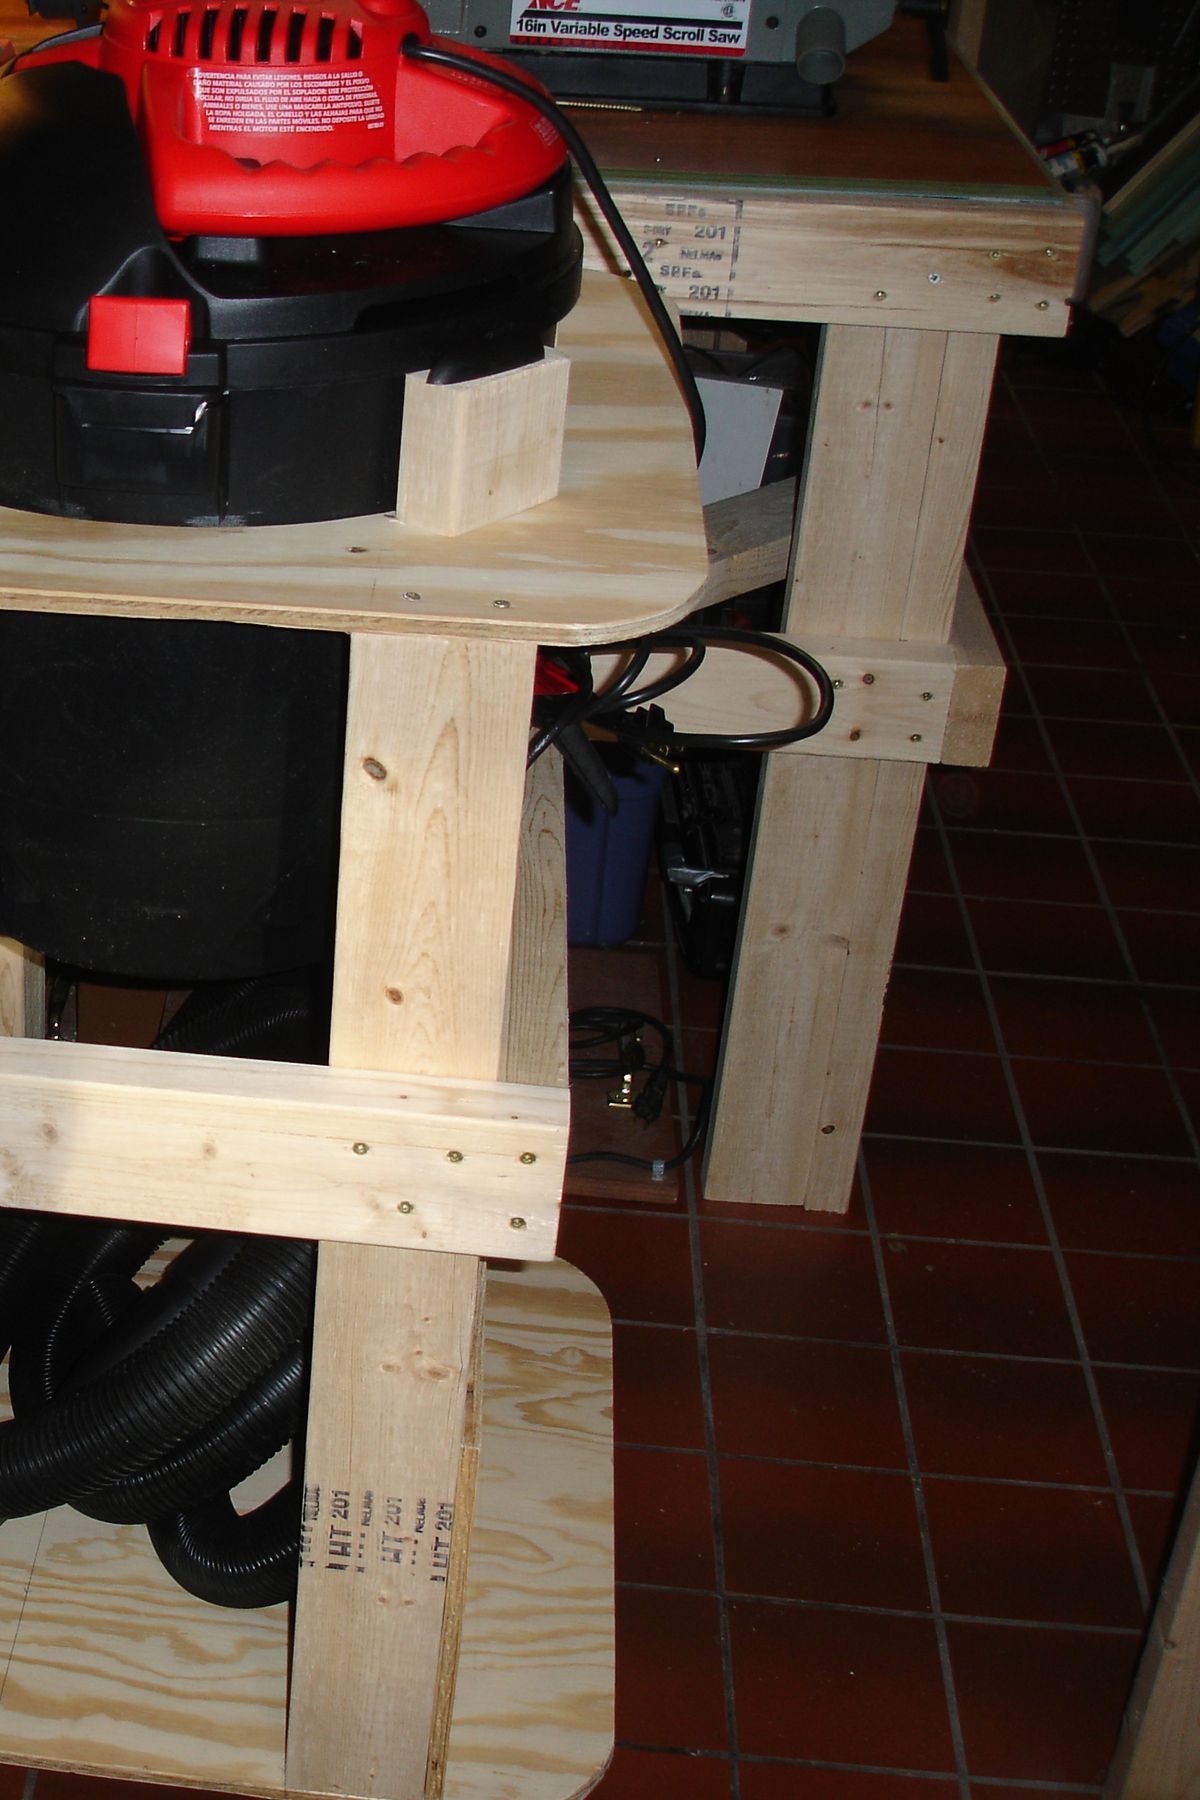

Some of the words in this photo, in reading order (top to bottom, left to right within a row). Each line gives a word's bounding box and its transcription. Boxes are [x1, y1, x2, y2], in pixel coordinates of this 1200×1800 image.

[517, 18, 547, 33] 16in
[551, 20, 610, 36] Variable
[613, 24, 659, 41] Speed
[663, 27, 705, 42] Scroll
[708, 30, 741, 44] Saw
[694, 225, 727, 240] 201
[688, 285, 720, 300] 201
[330, 1490, 350, 1520] 201
[384, 1497, 403, 1526] 201
[328, 1524, 352, 1557] HT
